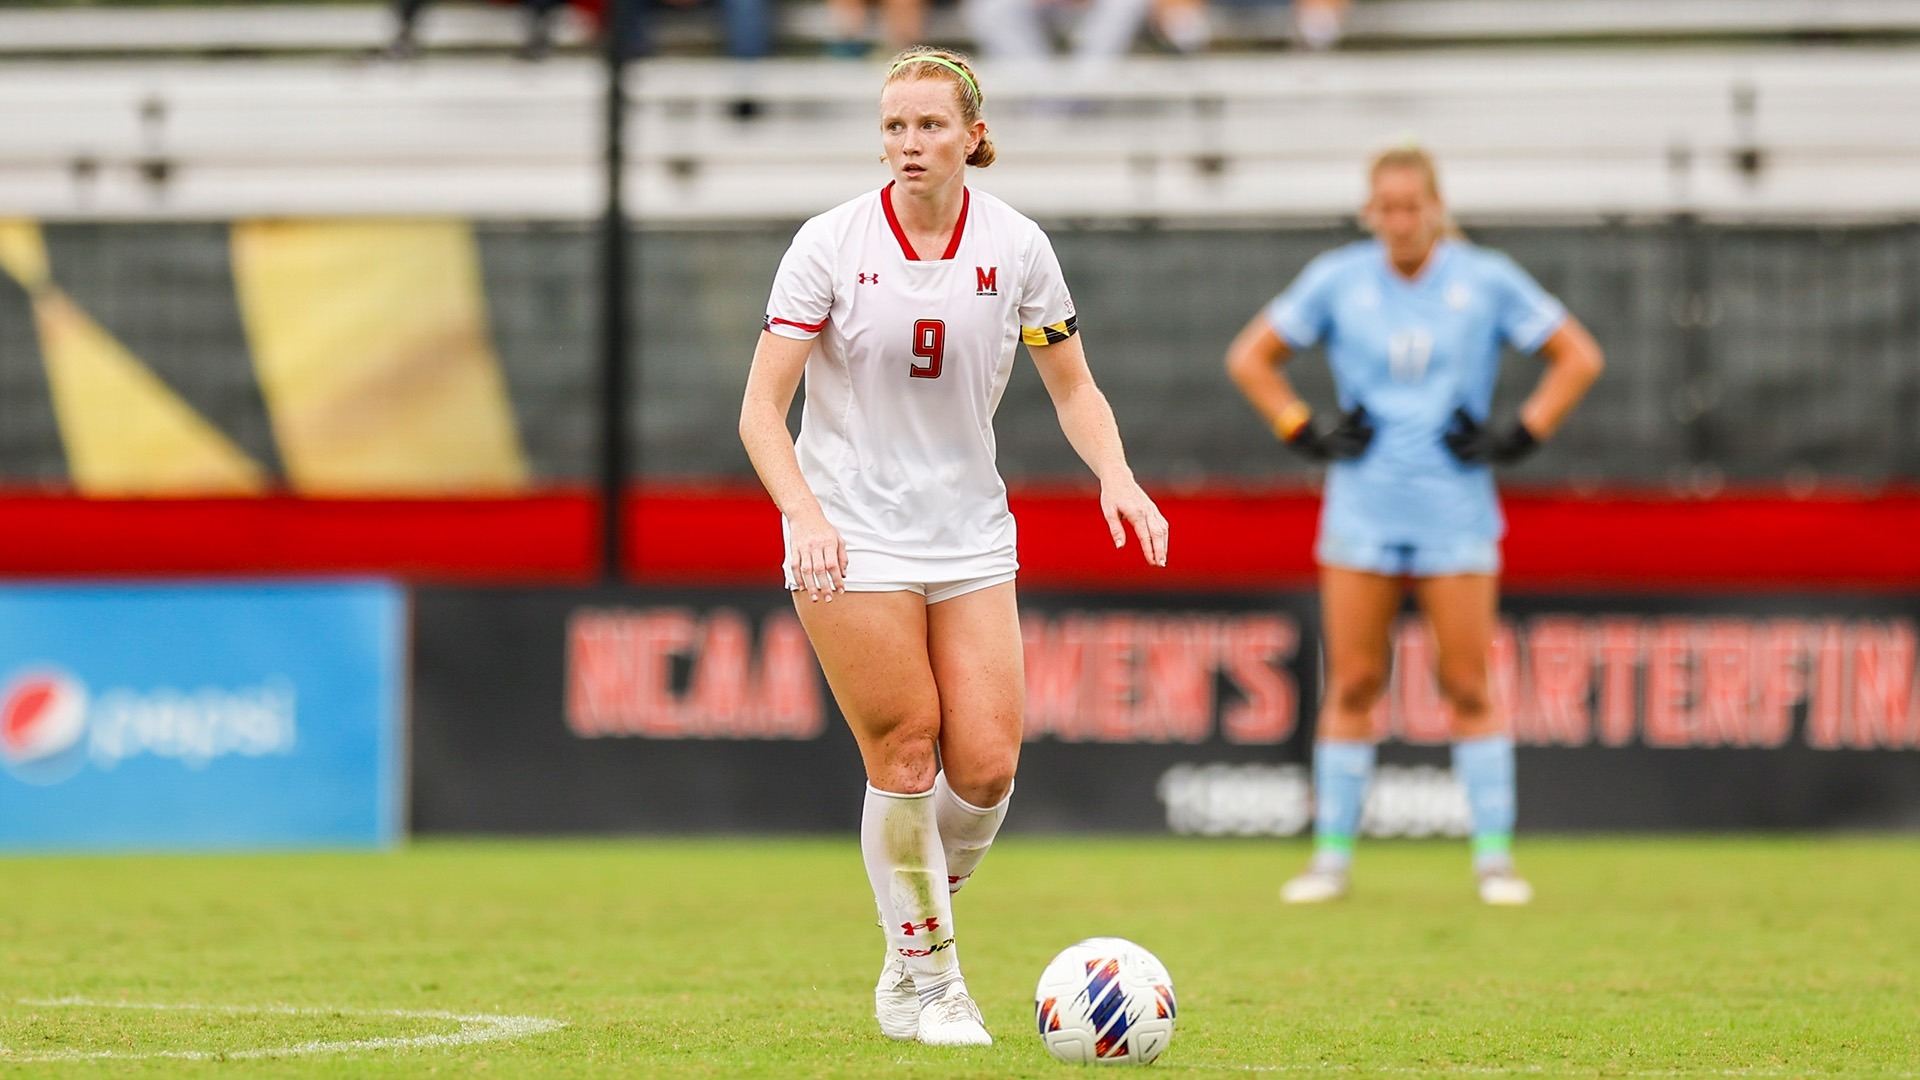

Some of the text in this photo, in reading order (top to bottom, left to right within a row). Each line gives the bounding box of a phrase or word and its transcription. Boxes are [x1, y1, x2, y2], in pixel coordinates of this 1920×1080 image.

[975, 266, 998, 292] M
[909, 319, 946, 379] 9
[563, 608, 1920, 749] NCAA MEN'S UARTERFIN
[89, 674, 296, 770] pepsi
